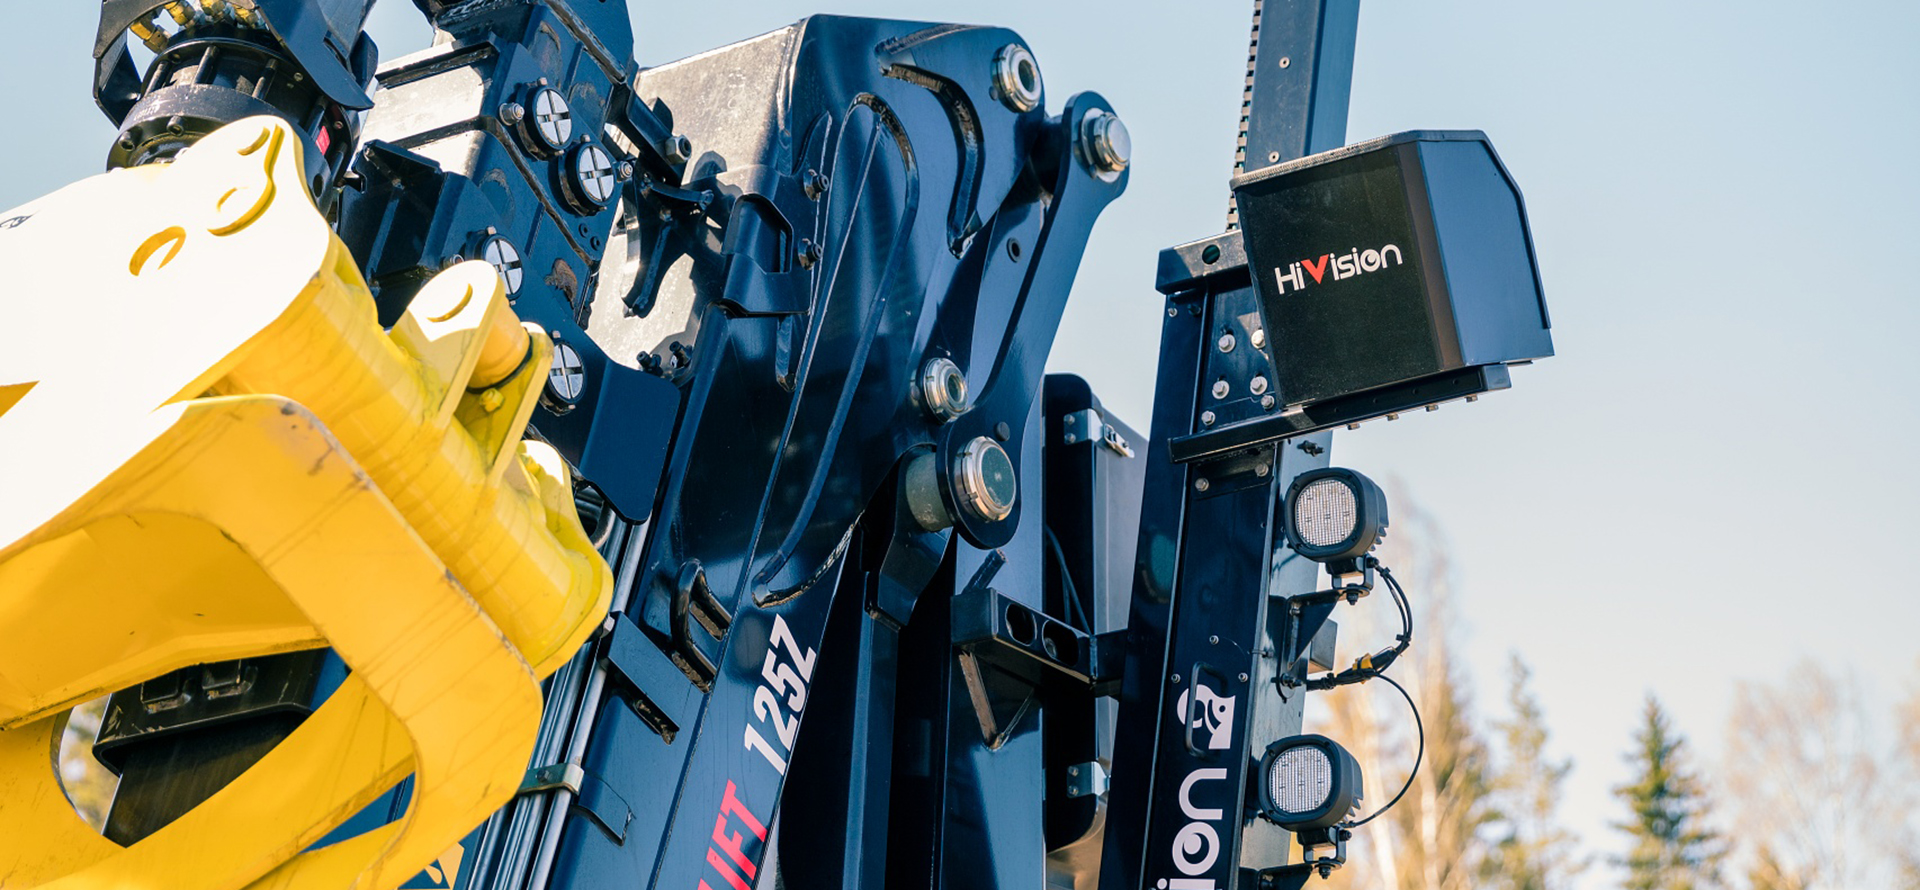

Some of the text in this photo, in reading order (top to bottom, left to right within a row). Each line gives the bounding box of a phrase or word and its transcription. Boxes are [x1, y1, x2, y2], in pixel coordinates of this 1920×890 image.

[1274, 244, 1403, 295] HiVision
[697, 613, 817, 890] IFT 125Z
